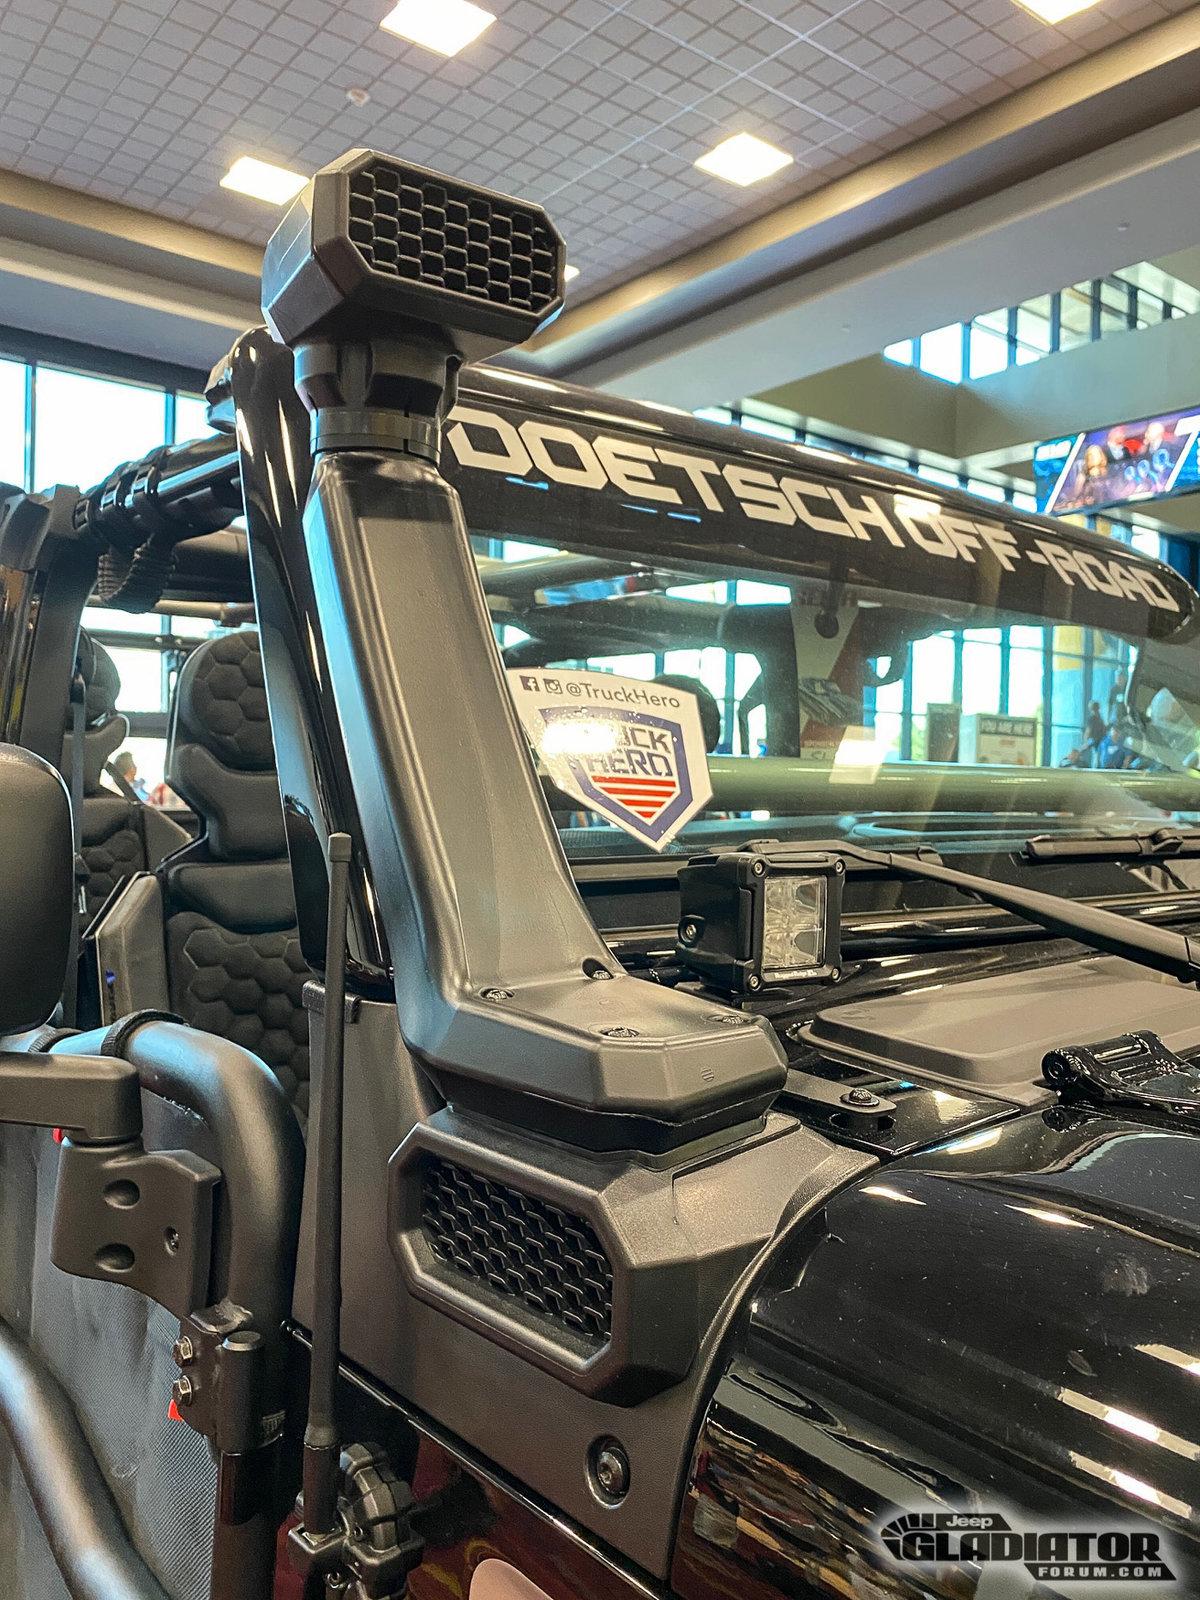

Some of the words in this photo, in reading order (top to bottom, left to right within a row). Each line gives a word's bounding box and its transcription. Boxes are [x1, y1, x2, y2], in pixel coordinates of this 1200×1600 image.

[446, 405, 905, 548] DOETSCH
[894, 495, 1180, 613] OFF-ROAD
[566, 682, 680, 708] @TruckHero
